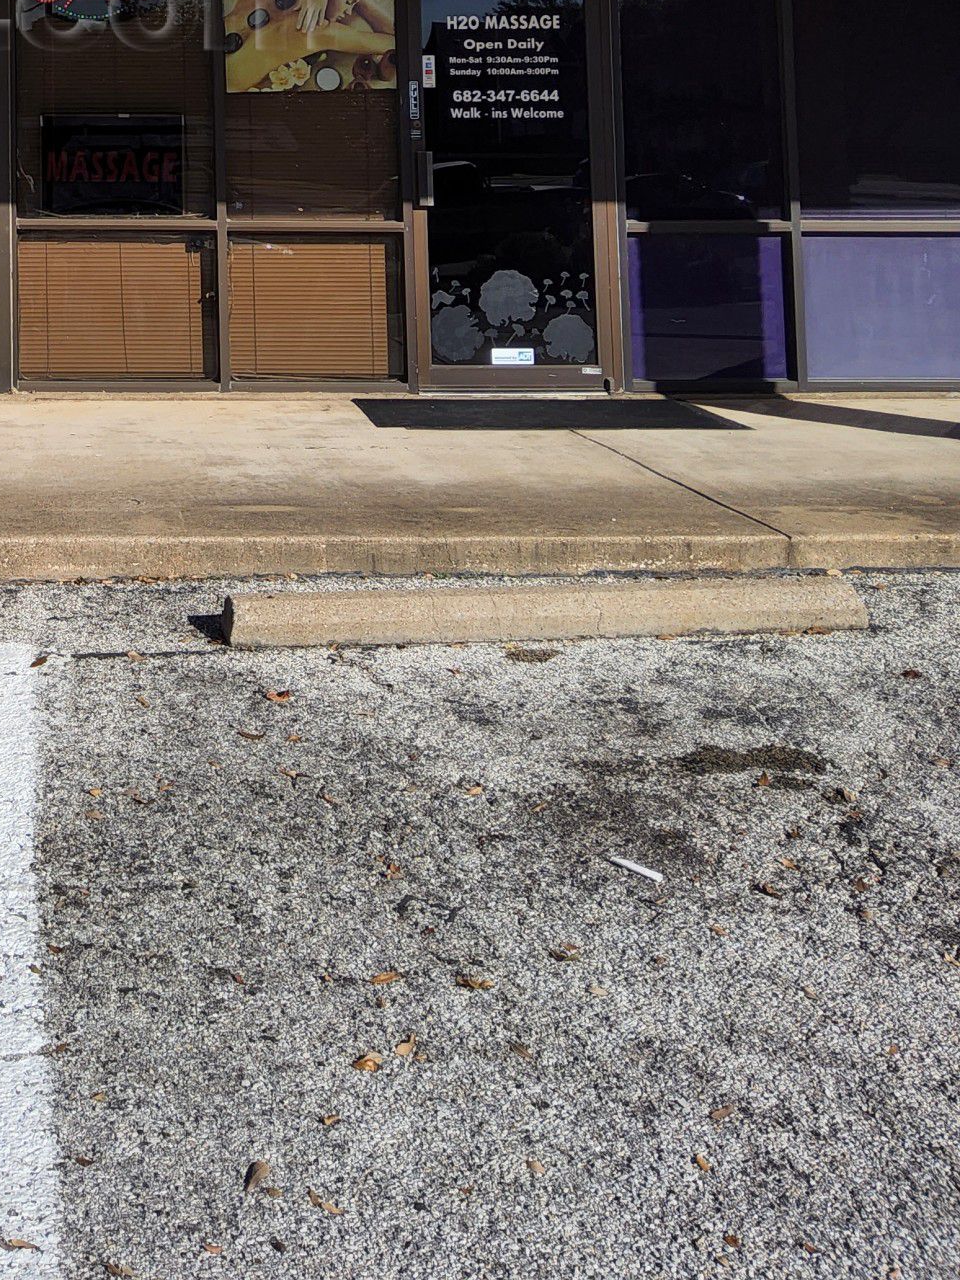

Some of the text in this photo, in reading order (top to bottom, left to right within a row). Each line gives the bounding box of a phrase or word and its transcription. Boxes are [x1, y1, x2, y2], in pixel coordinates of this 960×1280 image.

[484, 14, 560, 29] MASSAGE
[463, 37, 545, 52] Open Daily
[449, 56, 483, 64] Mon-Sat
[449, 67, 559, 77] Sunday 10:00Am-9:00Pm
[452, 89, 559, 103] 682-347-6644
[450, 107, 481, 119] Walk
[491, 107, 508, 119] ins
[510, 106, 565, 119] Welcome
[46, 149, 177, 183] MASSAGE
